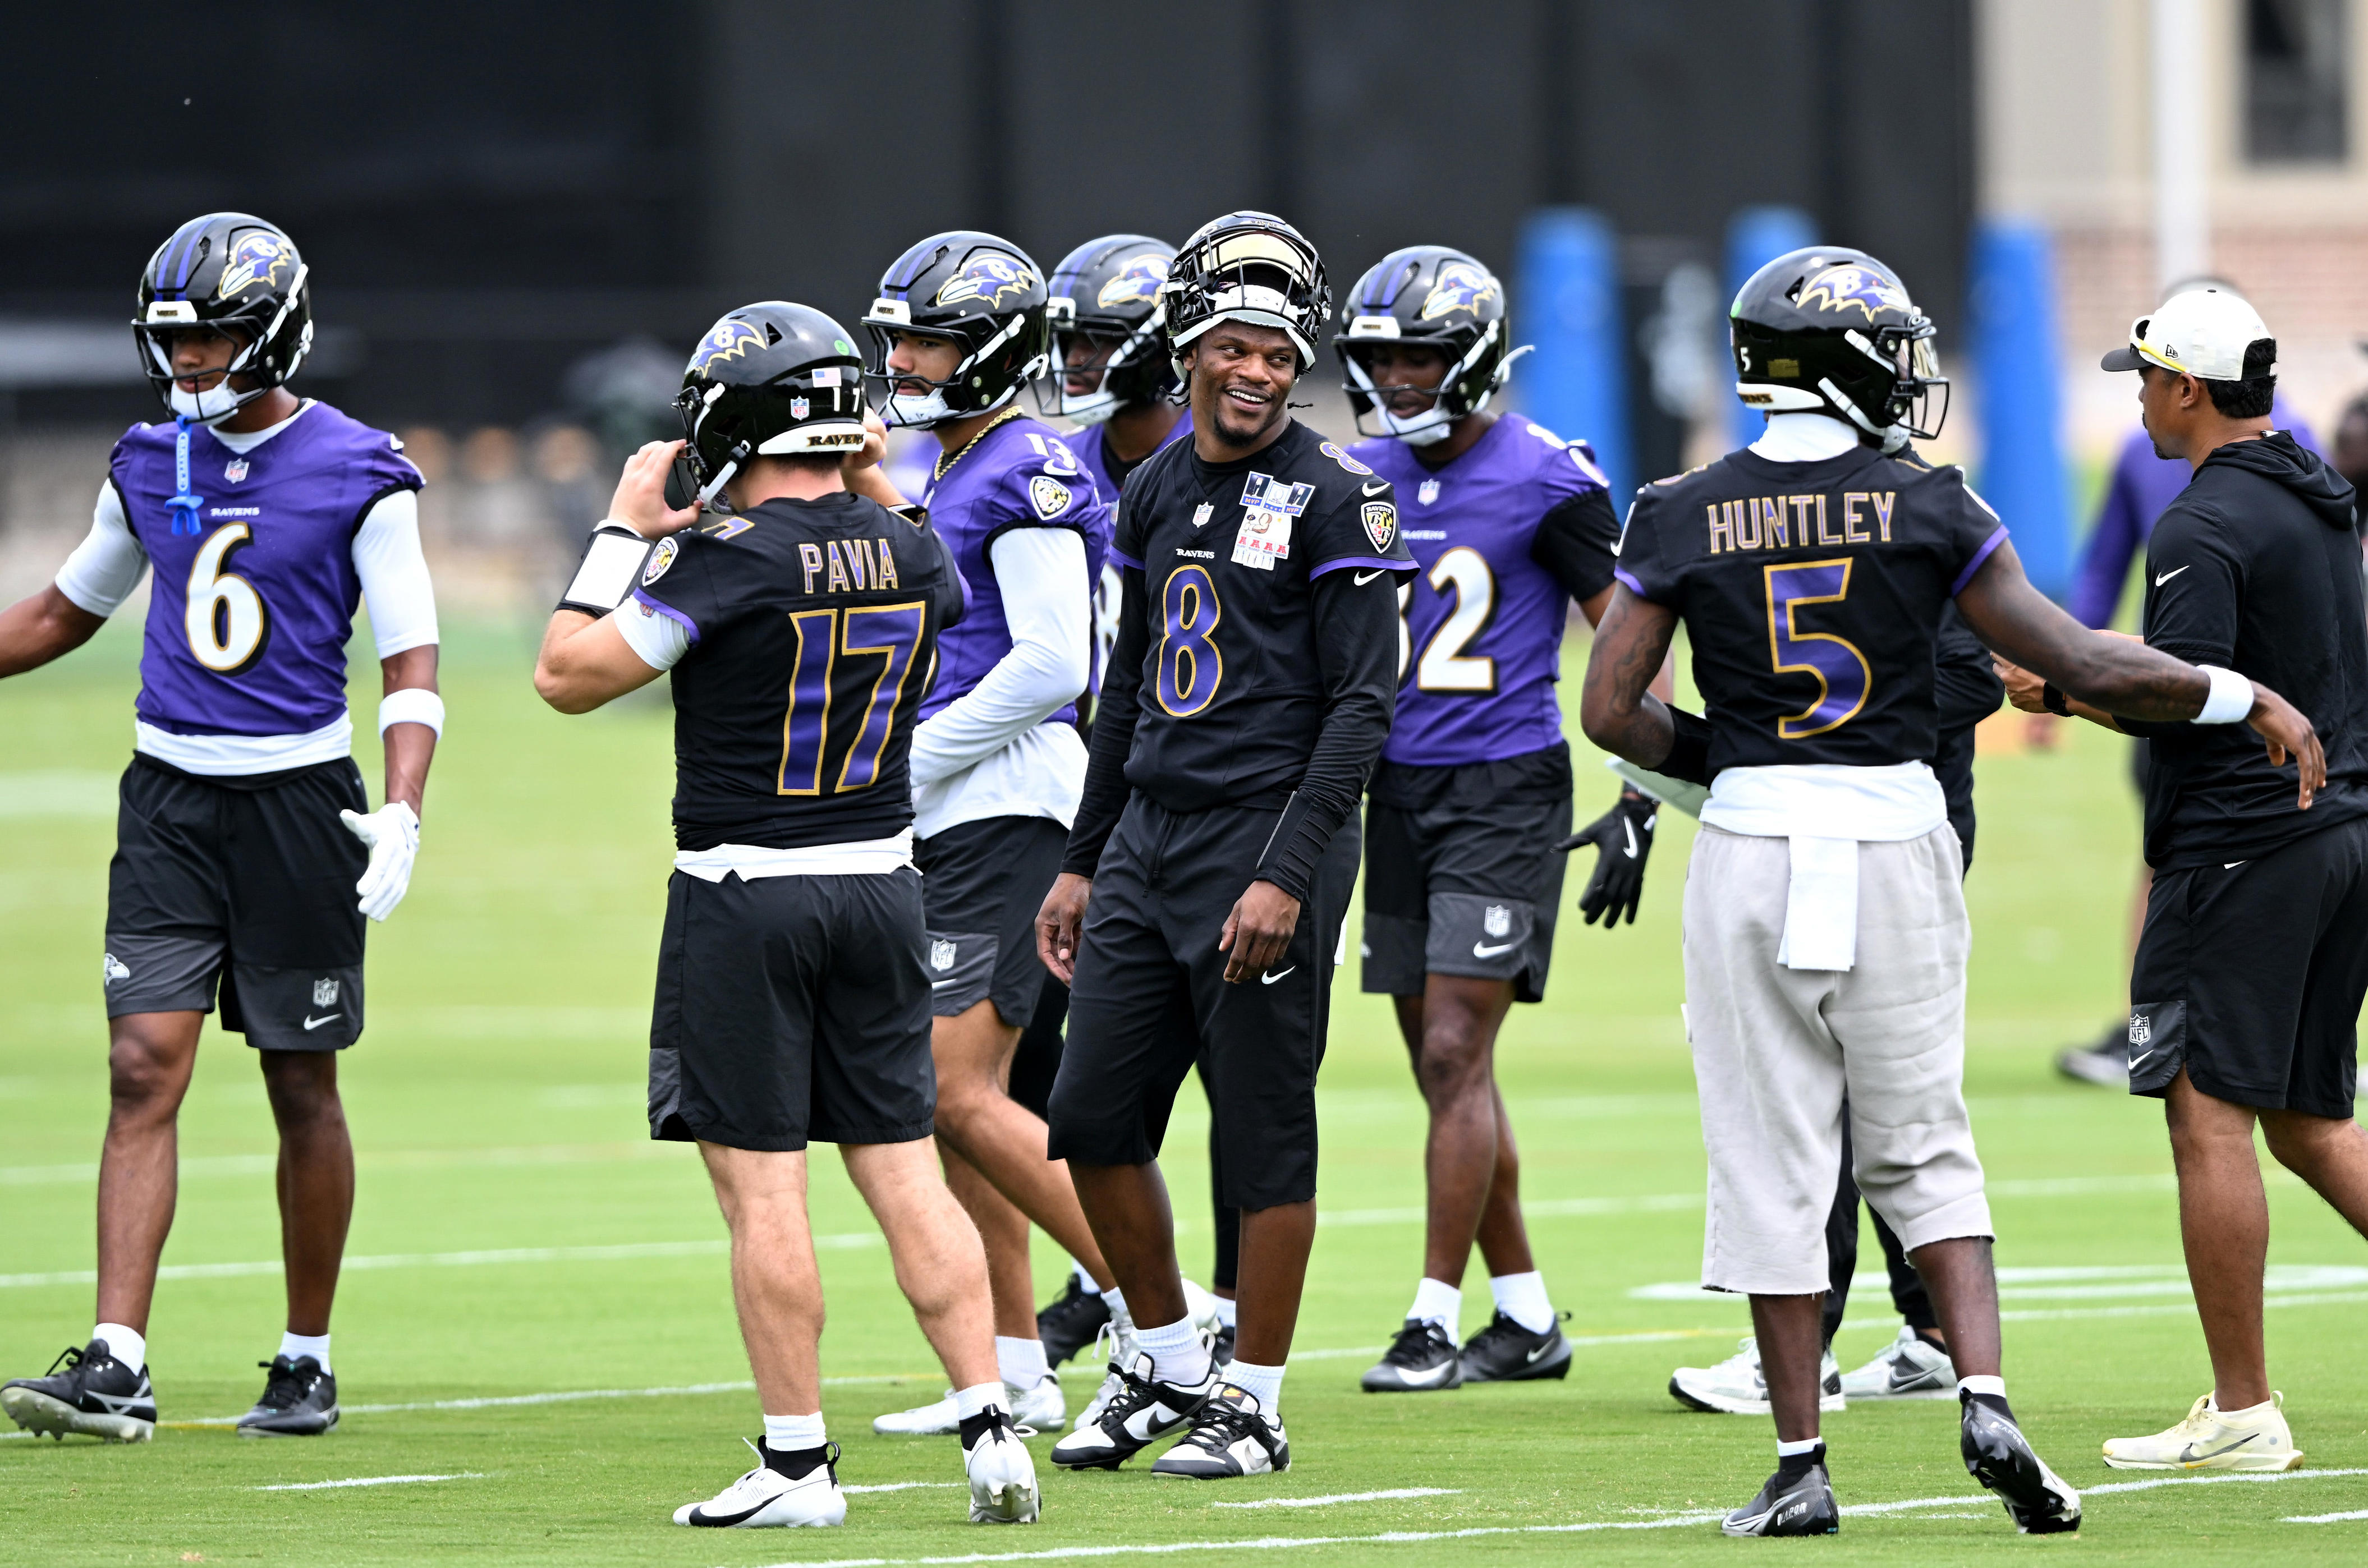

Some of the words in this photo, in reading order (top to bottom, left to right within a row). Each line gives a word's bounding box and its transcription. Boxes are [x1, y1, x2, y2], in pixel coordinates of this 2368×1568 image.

[1740, 347, 1751, 372] 5
[833, 387, 861, 413] 17
[1024, 433, 1078, 470] 13
[1319, 442, 1374, 476] 8
[210, 507, 260, 517] RAVENS
[1365, 505, 1392, 514] RAVENS
[1707, 491, 1896, 554] HUNTLEY
[798, 539, 898, 594] PAVIA
[1176, 548, 1215, 559] RAVENS
[184, 520, 268, 677] 6
[1396, 545, 1495, 691] 2
[1156, 564, 1223, 718] 8
[1764, 557, 1872, 739] 5
[777, 600, 925, 796] 17
[2131, 1028, 2148, 1041] NFL
